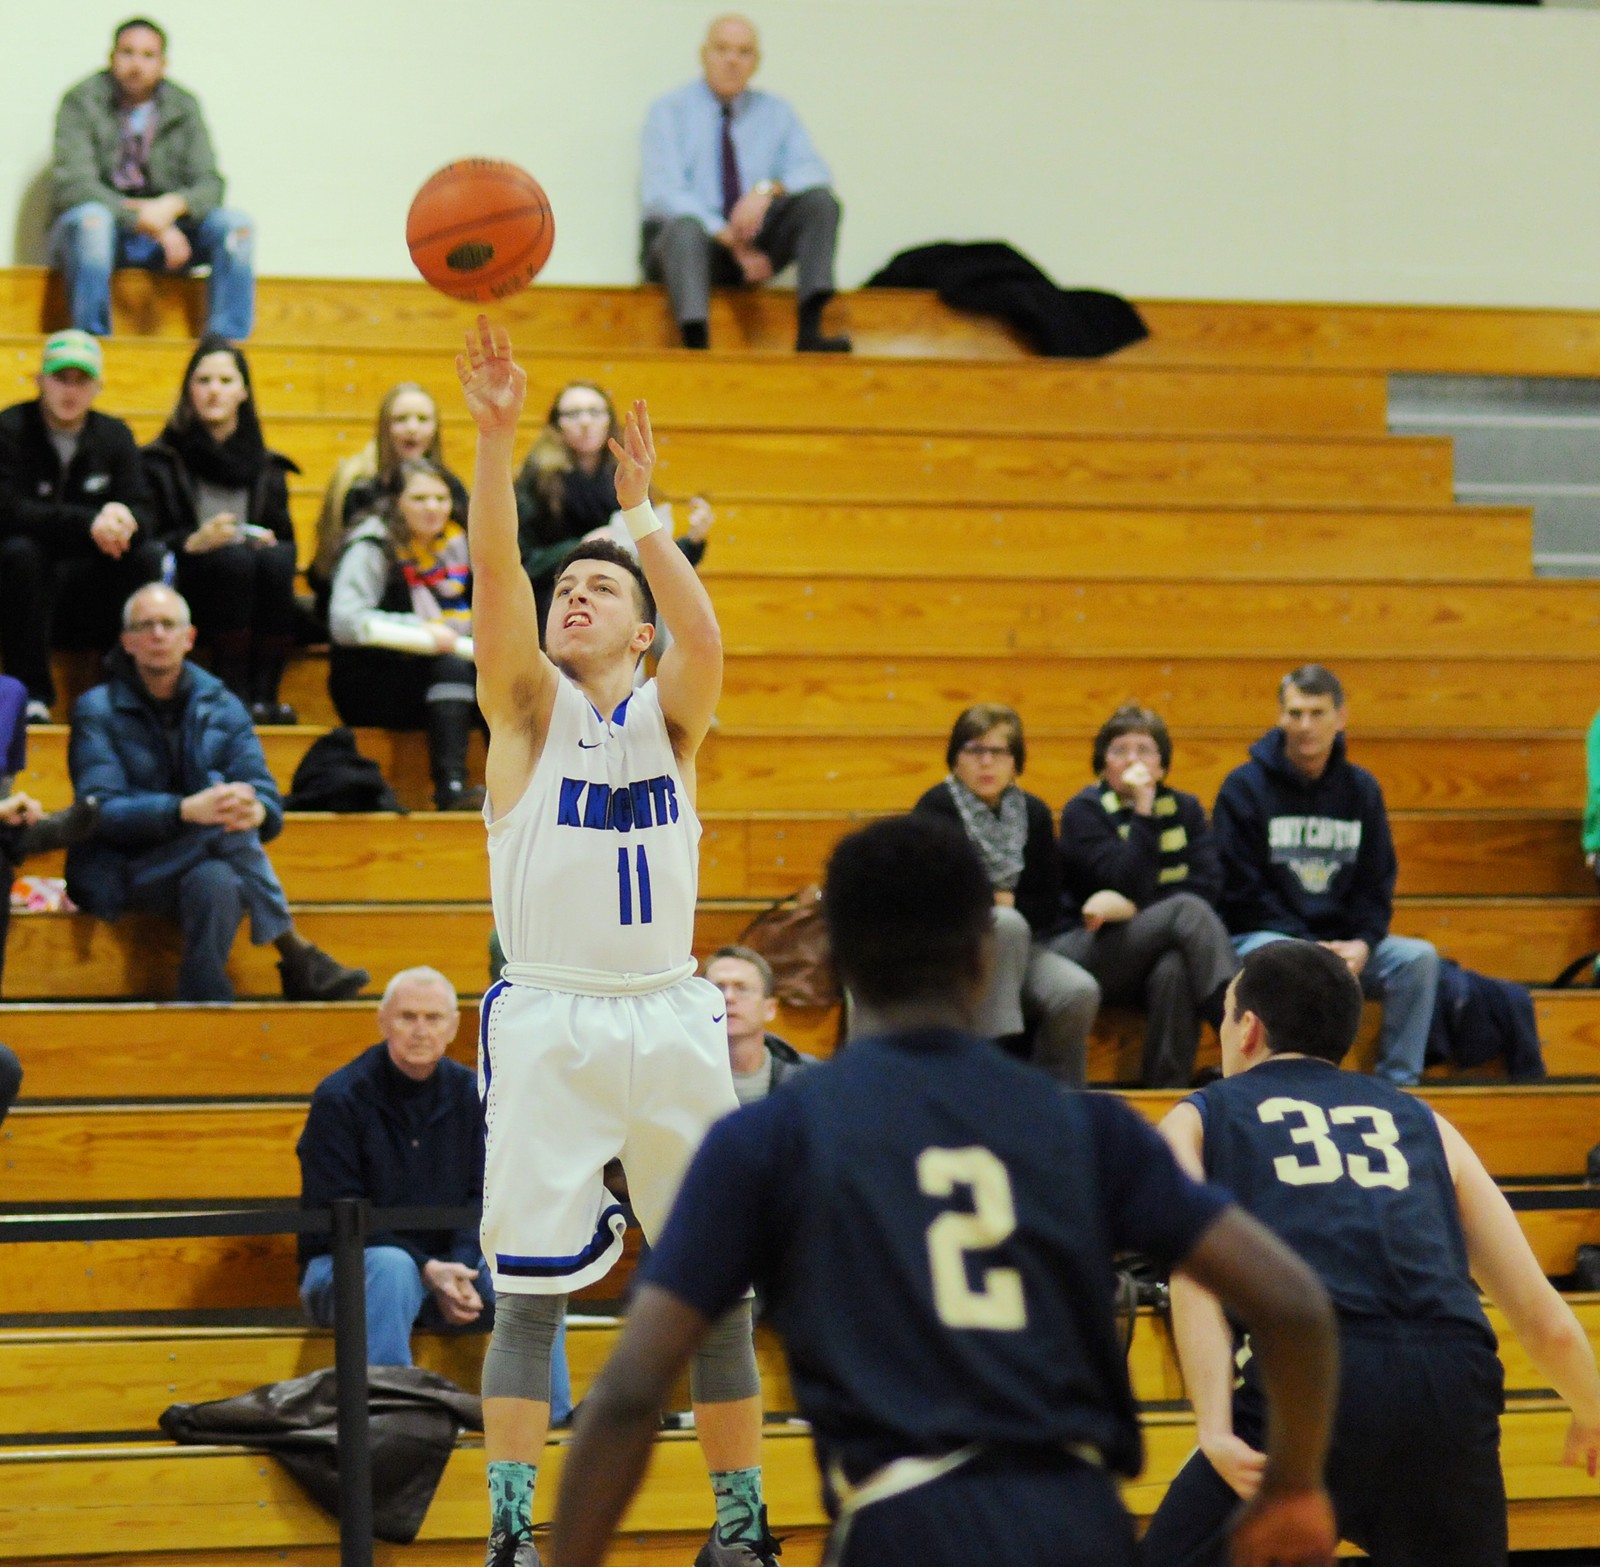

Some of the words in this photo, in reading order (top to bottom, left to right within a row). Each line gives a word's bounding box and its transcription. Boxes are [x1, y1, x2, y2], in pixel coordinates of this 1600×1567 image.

[557, 774, 679, 833] KNIGHTS
[617, 844, 652, 925] 11
[1257, 1097, 1410, 1191] 33
[916, 1146, 1027, 1332] 2
